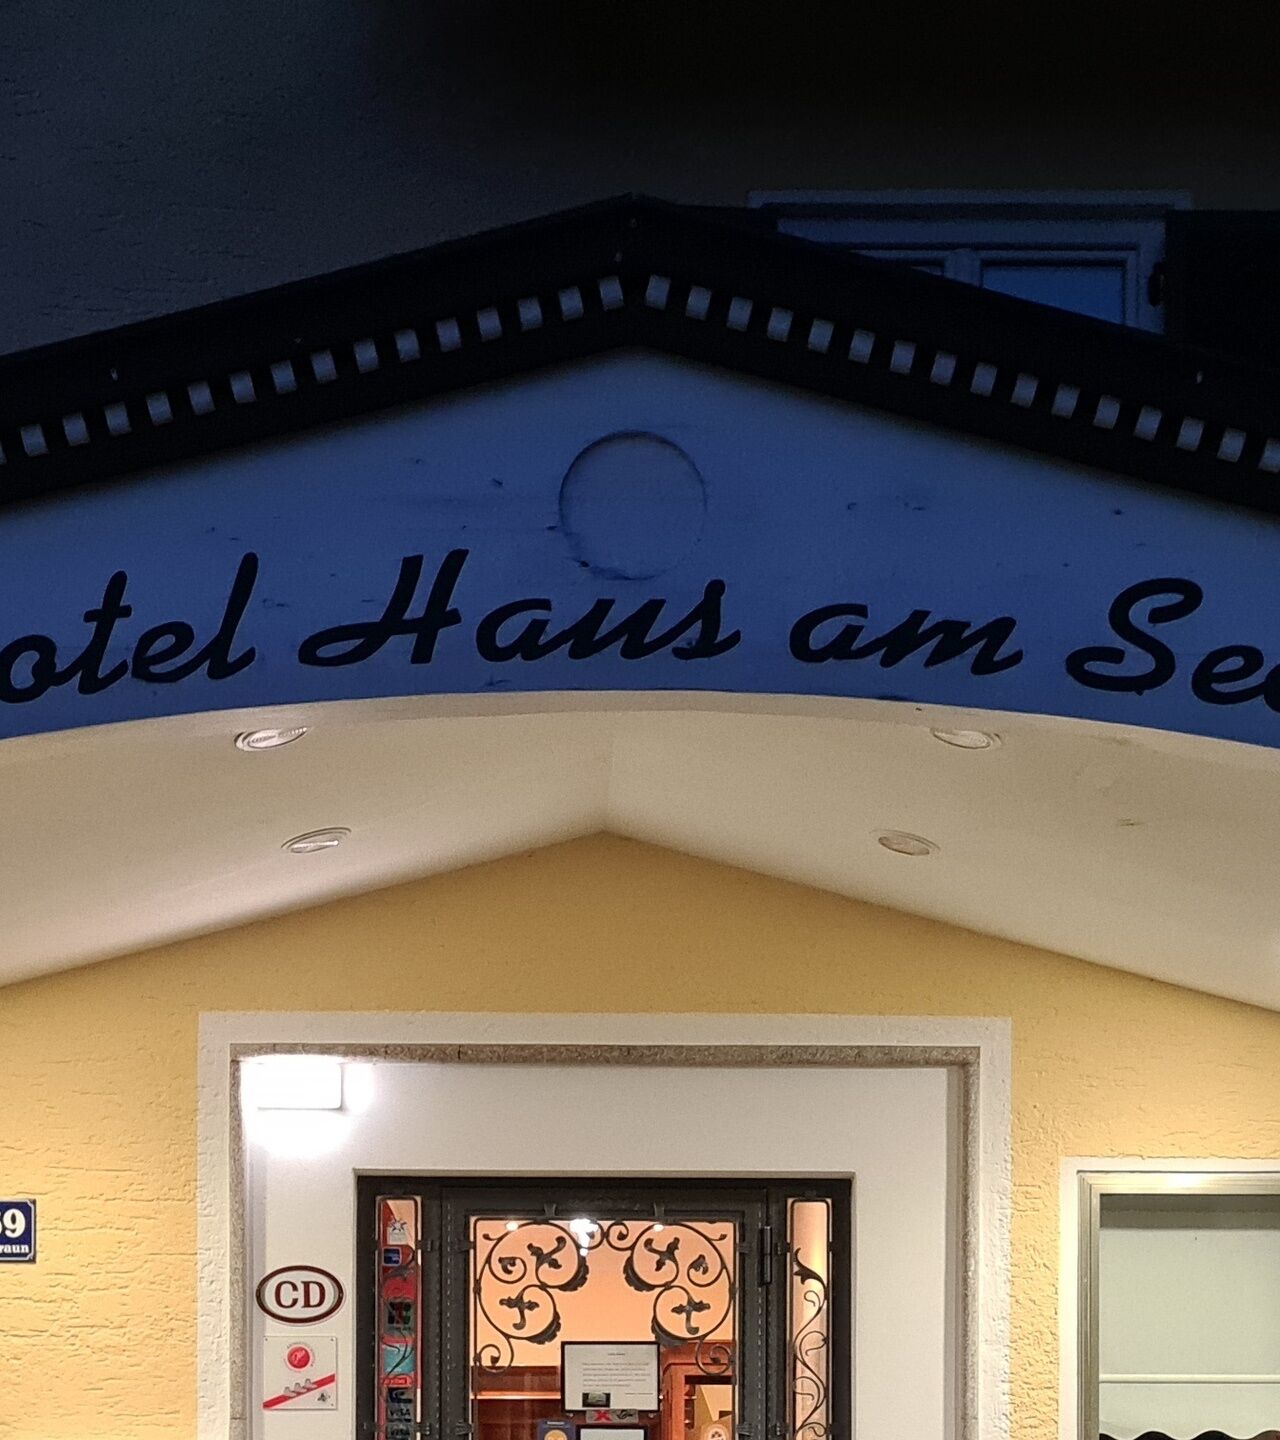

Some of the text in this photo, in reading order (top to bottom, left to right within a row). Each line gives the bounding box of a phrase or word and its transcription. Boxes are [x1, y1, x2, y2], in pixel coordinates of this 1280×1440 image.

[297, 547, 742, 668] Haus
[788, 603, 1024, 676] am
[274, 1280, 326, 1309] CD
